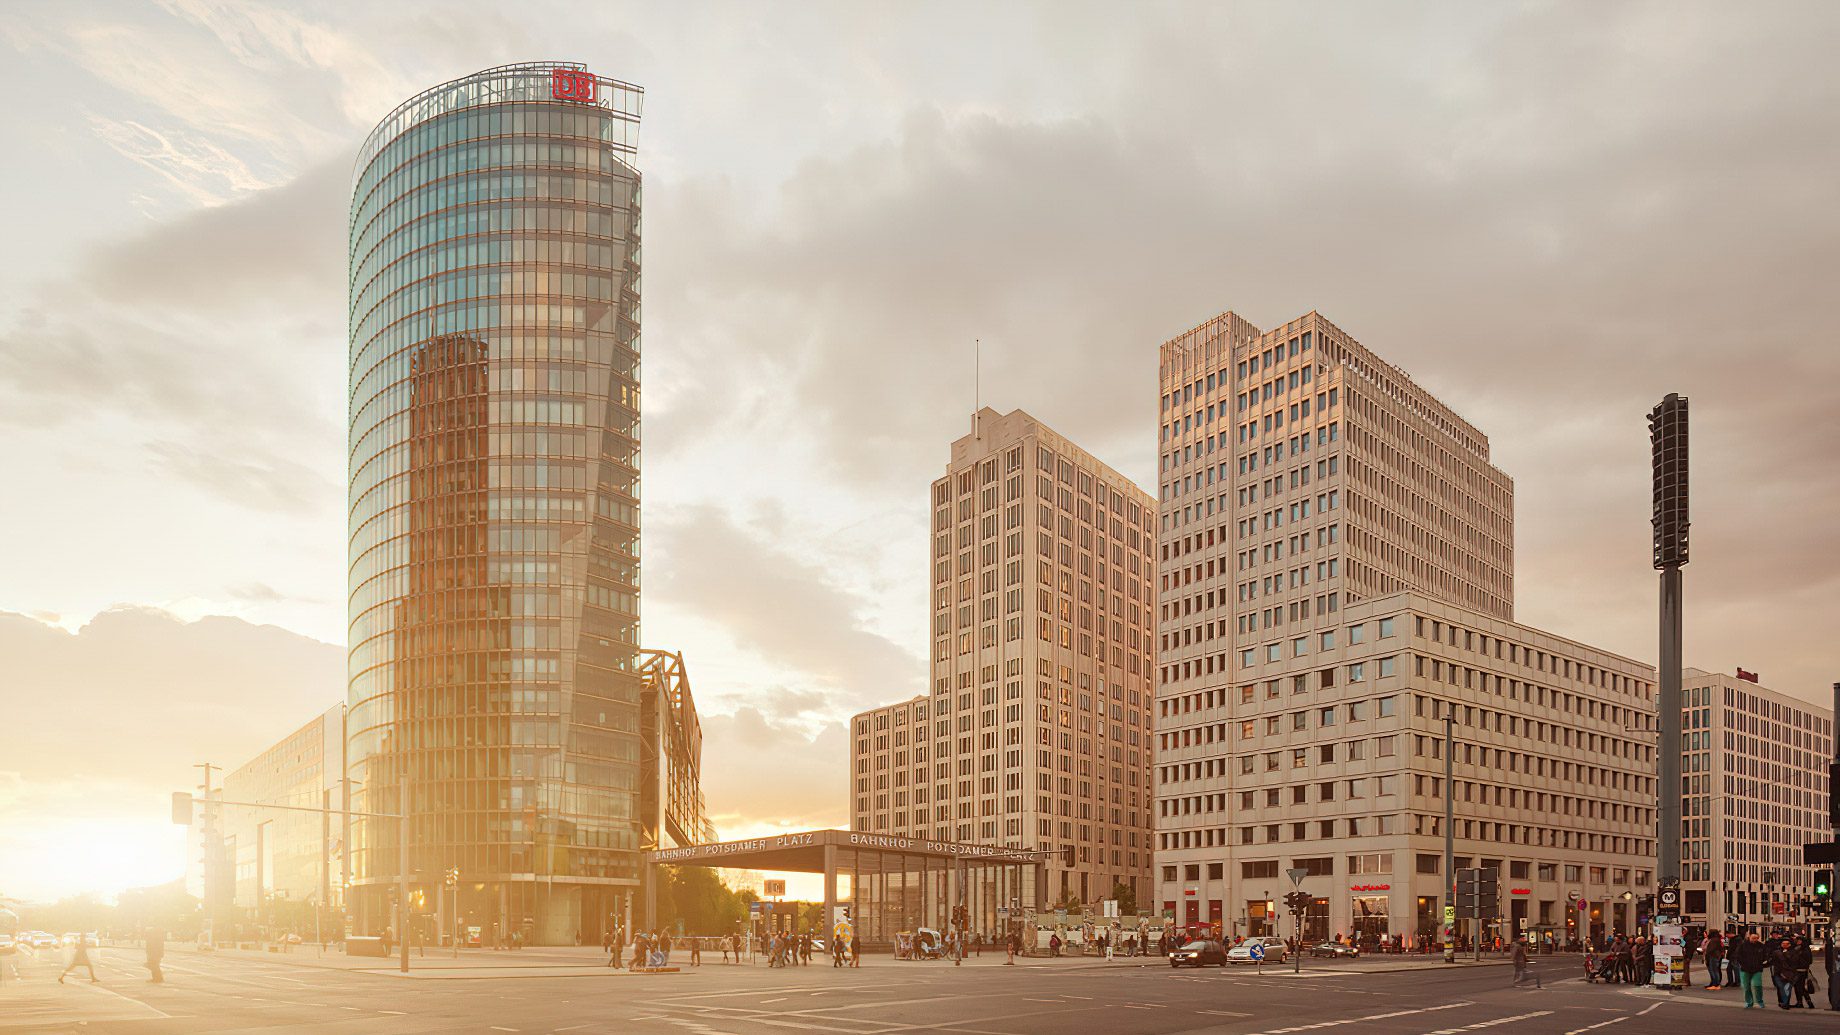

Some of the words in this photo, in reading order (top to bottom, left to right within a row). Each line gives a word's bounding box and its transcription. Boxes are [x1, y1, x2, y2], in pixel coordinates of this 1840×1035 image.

[556, 73, 592, 99] DB
[655, 847, 697, 860] BAHNHOF
[705, 840, 767, 855] POTSDAMER
[776, 833, 813, 847] PLATZ
[850, 833, 915, 849] BAHNHOF
[927, 841, 994, 857] POTSDAMER
